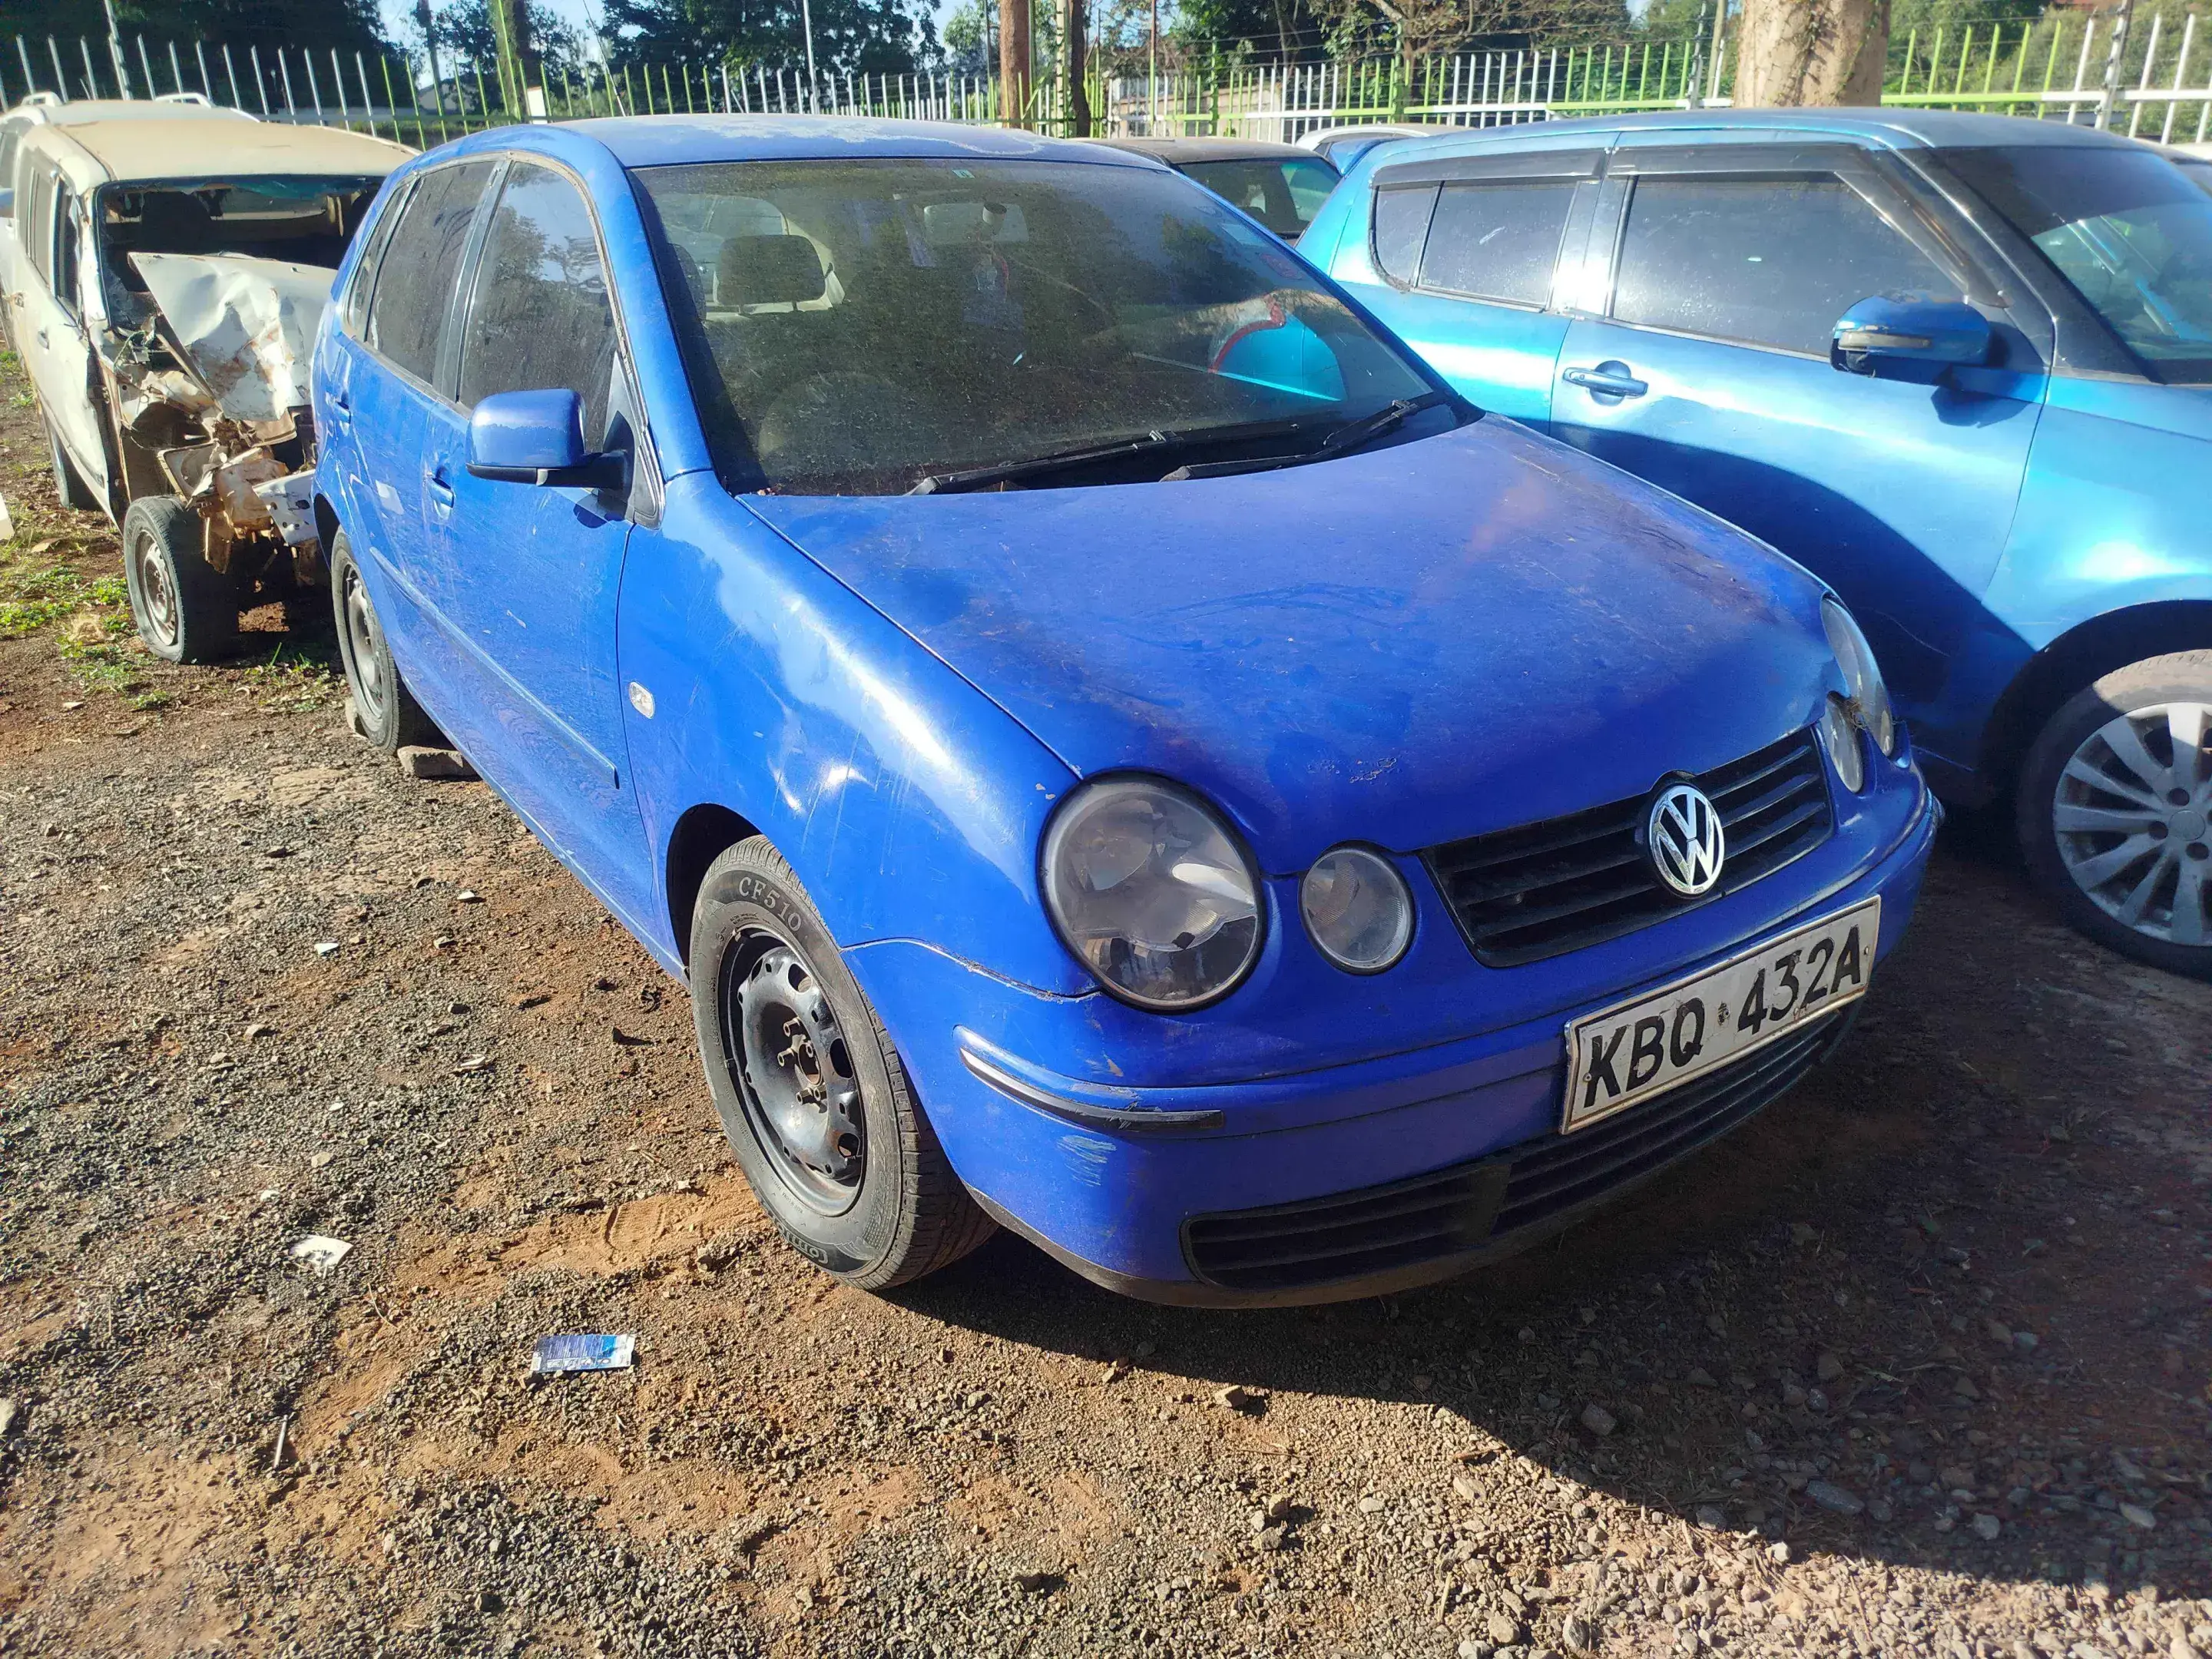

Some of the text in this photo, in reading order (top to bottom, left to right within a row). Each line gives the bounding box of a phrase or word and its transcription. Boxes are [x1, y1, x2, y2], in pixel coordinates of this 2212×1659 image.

[1650, 786, 1724, 894] VW
[739, 876, 801, 932] CF510
[1584, 925, 1862, 1108] KBQ 432A
